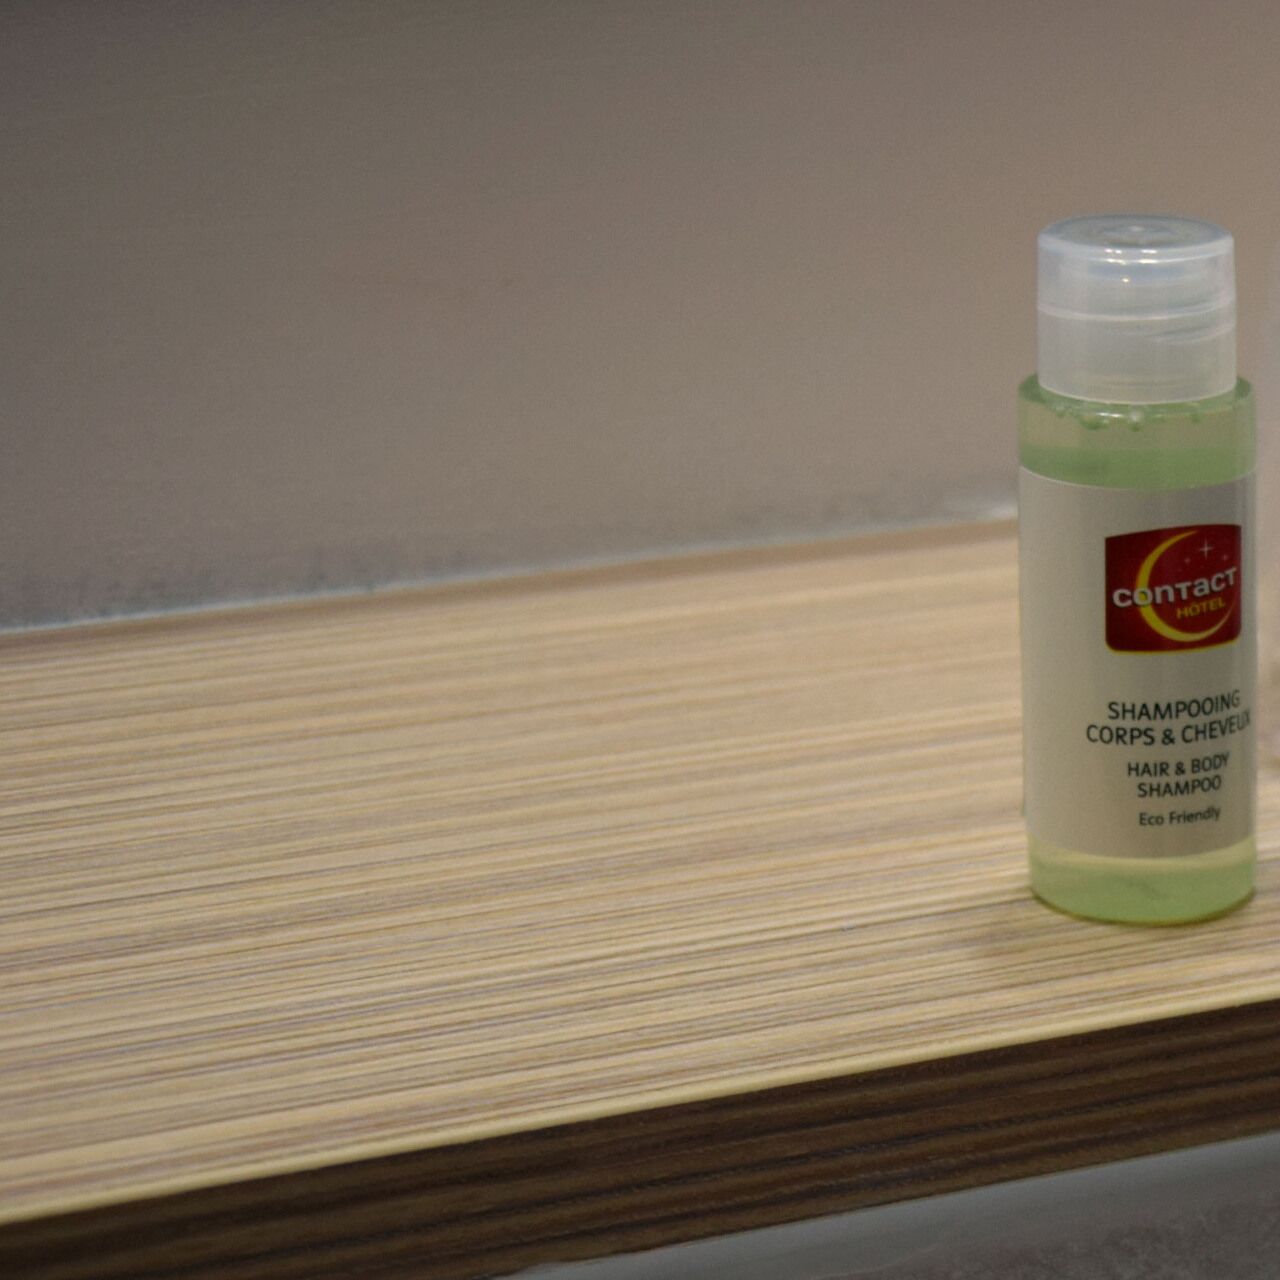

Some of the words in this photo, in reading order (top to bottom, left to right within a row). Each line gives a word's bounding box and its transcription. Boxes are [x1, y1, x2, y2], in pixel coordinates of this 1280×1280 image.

[1176, 596, 1226, 619] HÔTEL
[1107, 688, 1241, 721] SHAMPOOING
[1086, 724, 1156, 746] CORPS
[1161, 728, 1176, 746] &
[1127, 761, 1171, 777] HAIR
[1174, 761, 1186, 776] &
[1191, 752, 1229, 774] BODY
[1137, 774, 1222, 798] SHAMPOO
[1138, 812, 1165, 827] Eco
[1168, 804, 1221, 826] Friendly
